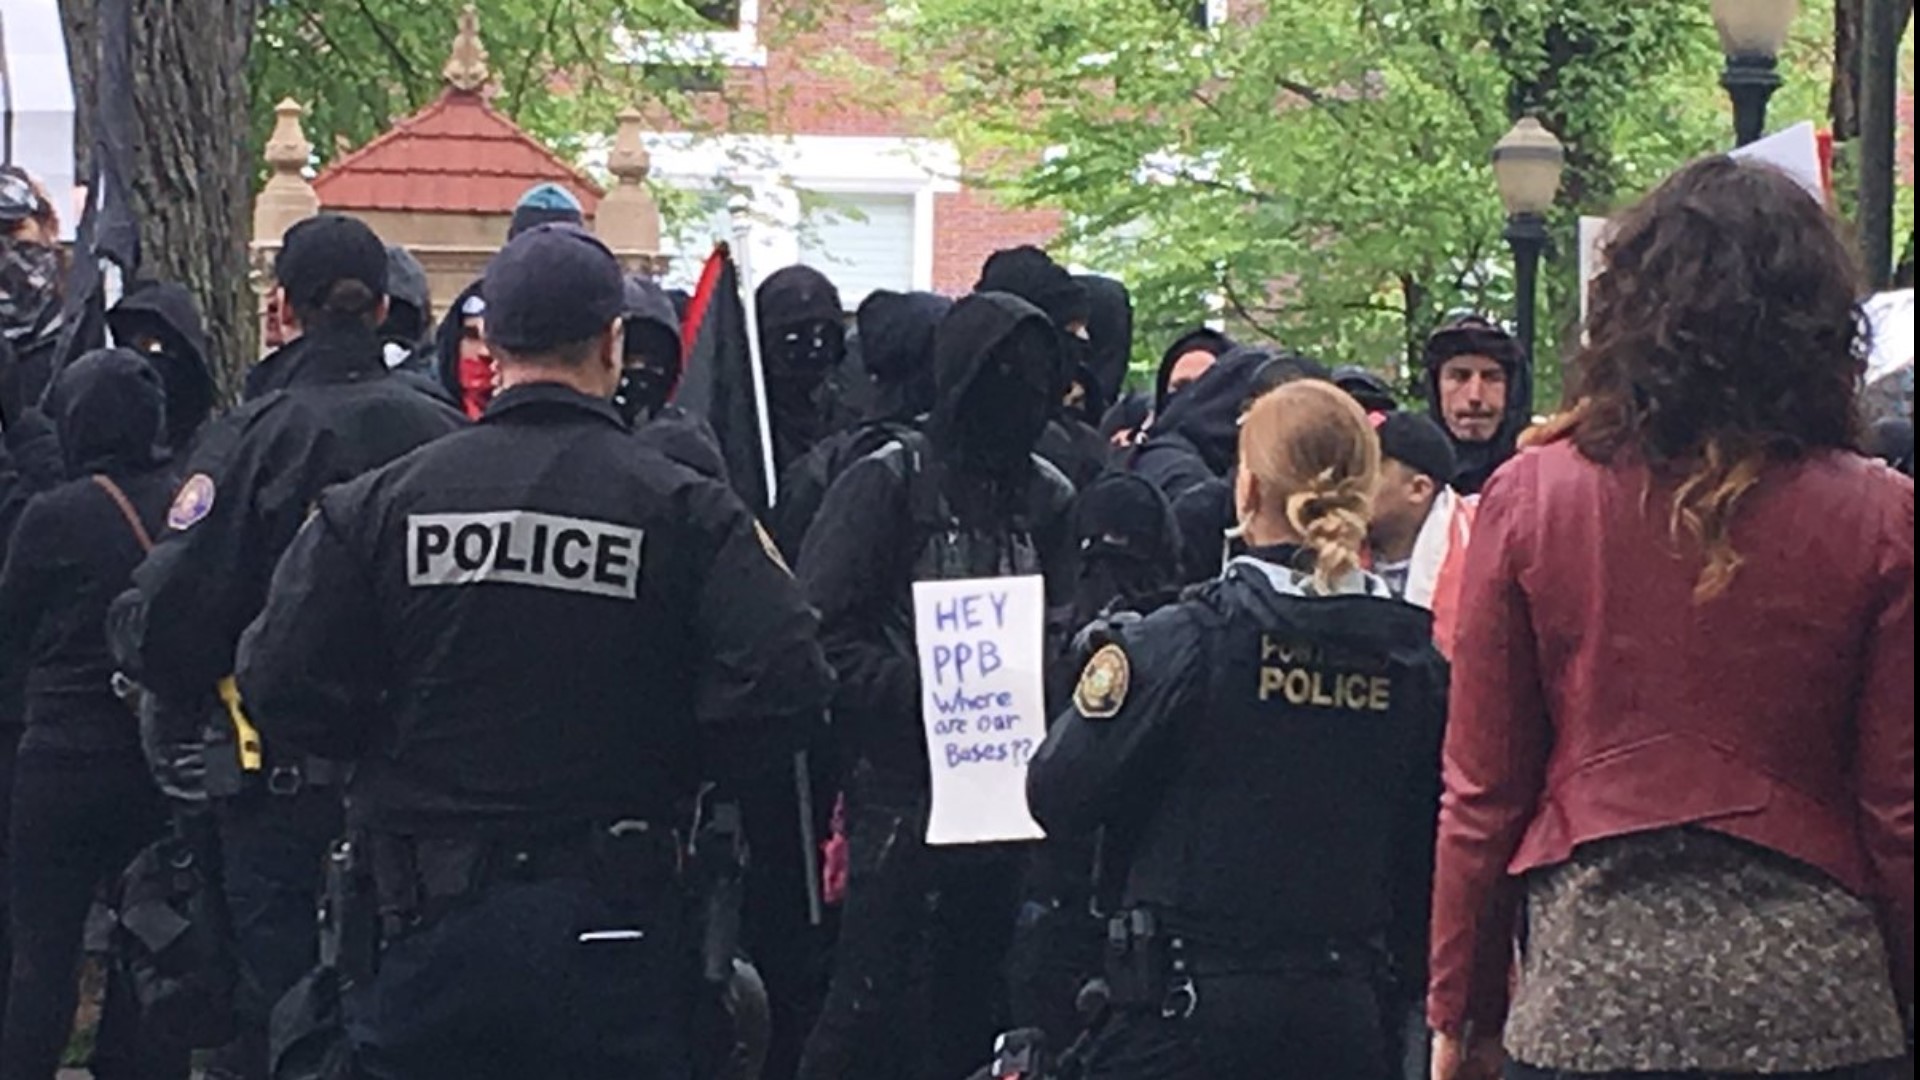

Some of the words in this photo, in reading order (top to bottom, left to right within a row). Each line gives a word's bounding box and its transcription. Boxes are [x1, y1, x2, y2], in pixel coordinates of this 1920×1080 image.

[417, 521, 632, 588] POLICE
[936, 591, 1007, 632] HEY
[933, 639, 1002, 684] PPB
[932, 686, 1013, 715] Where
[1258, 665, 1391, 711] POLICE
[933, 717, 968, 735] are
[976, 714, 1021, 733] our
